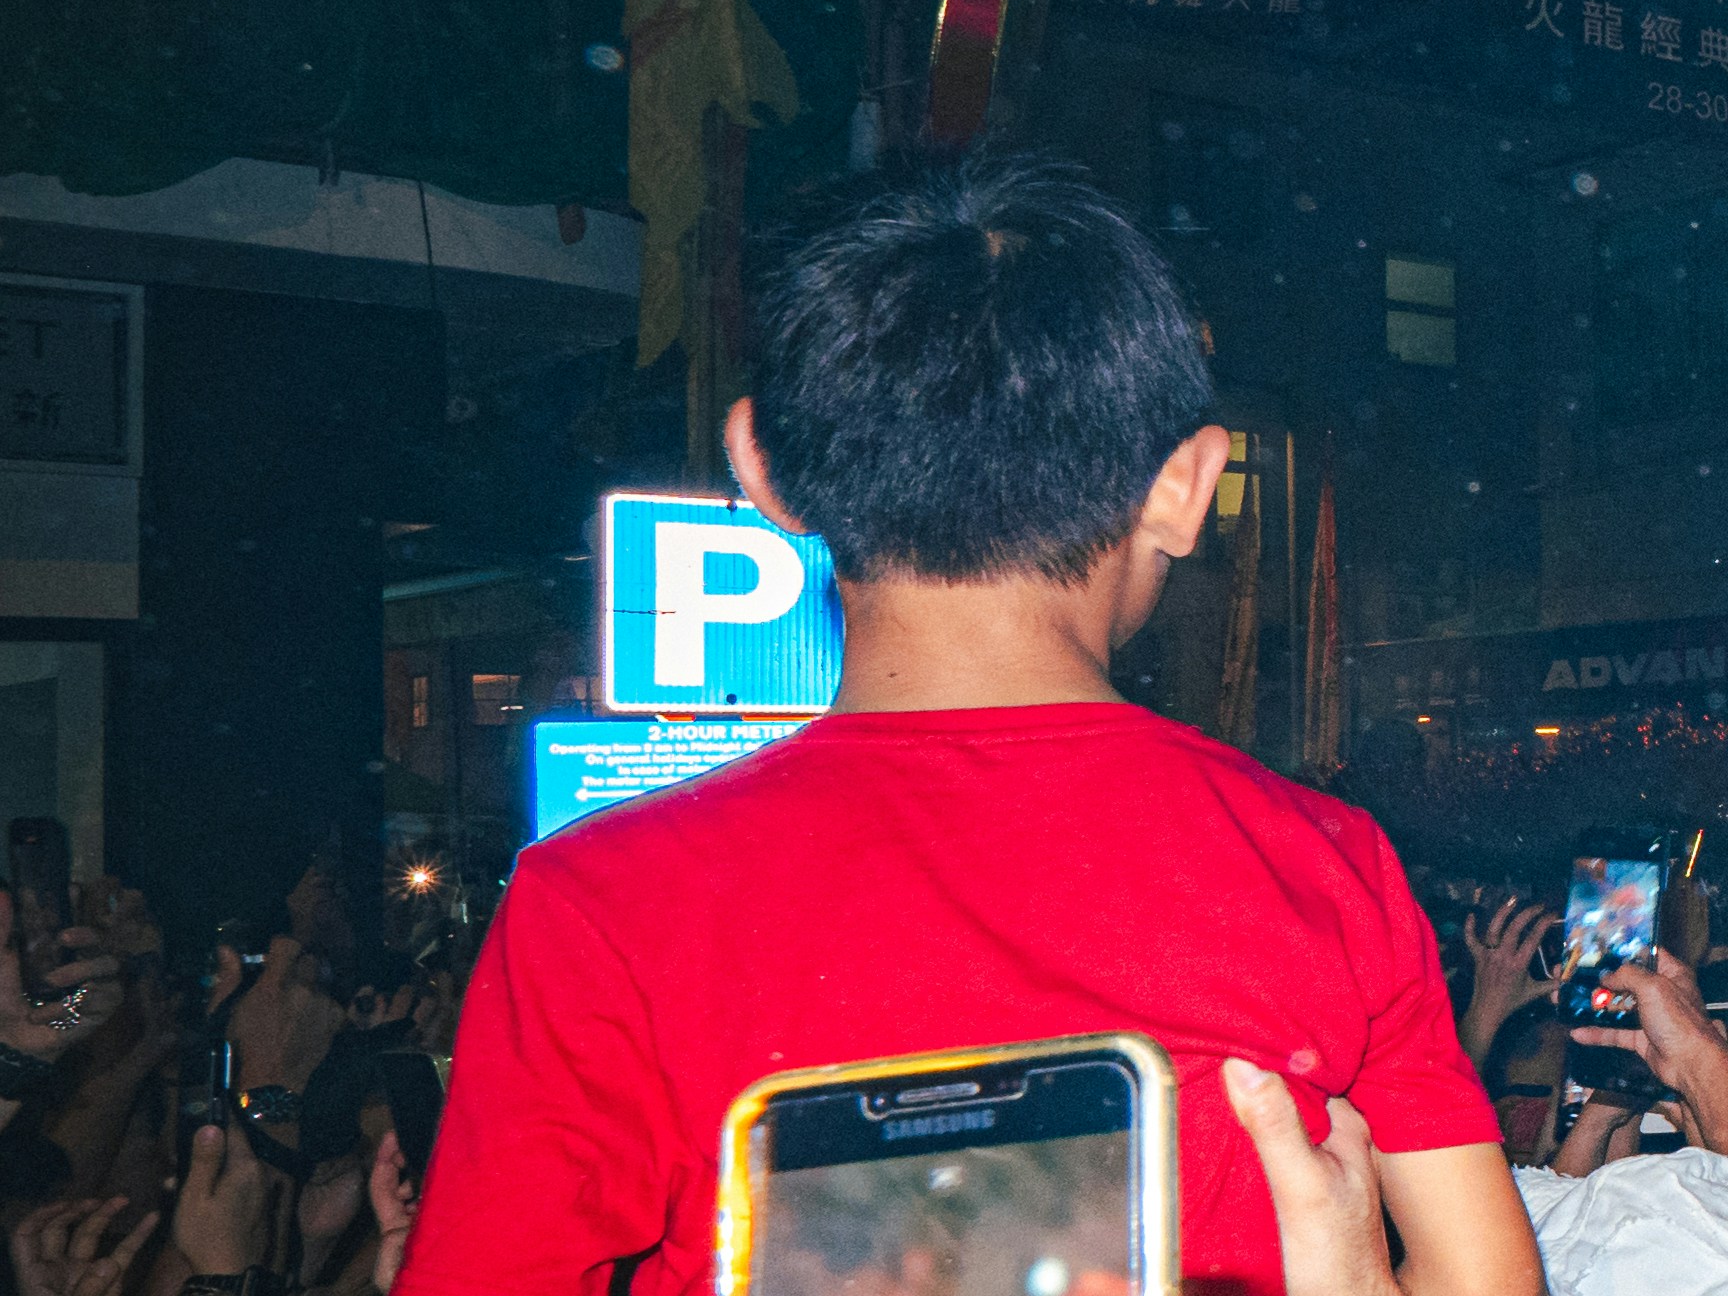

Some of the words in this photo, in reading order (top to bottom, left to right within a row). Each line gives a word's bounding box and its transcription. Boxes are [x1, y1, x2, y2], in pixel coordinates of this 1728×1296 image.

[653, 520, 806, 687] P
[648, 724, 727, 741] 2-HOUR
[883, 1108, 996, 1141] SAMSUNG
